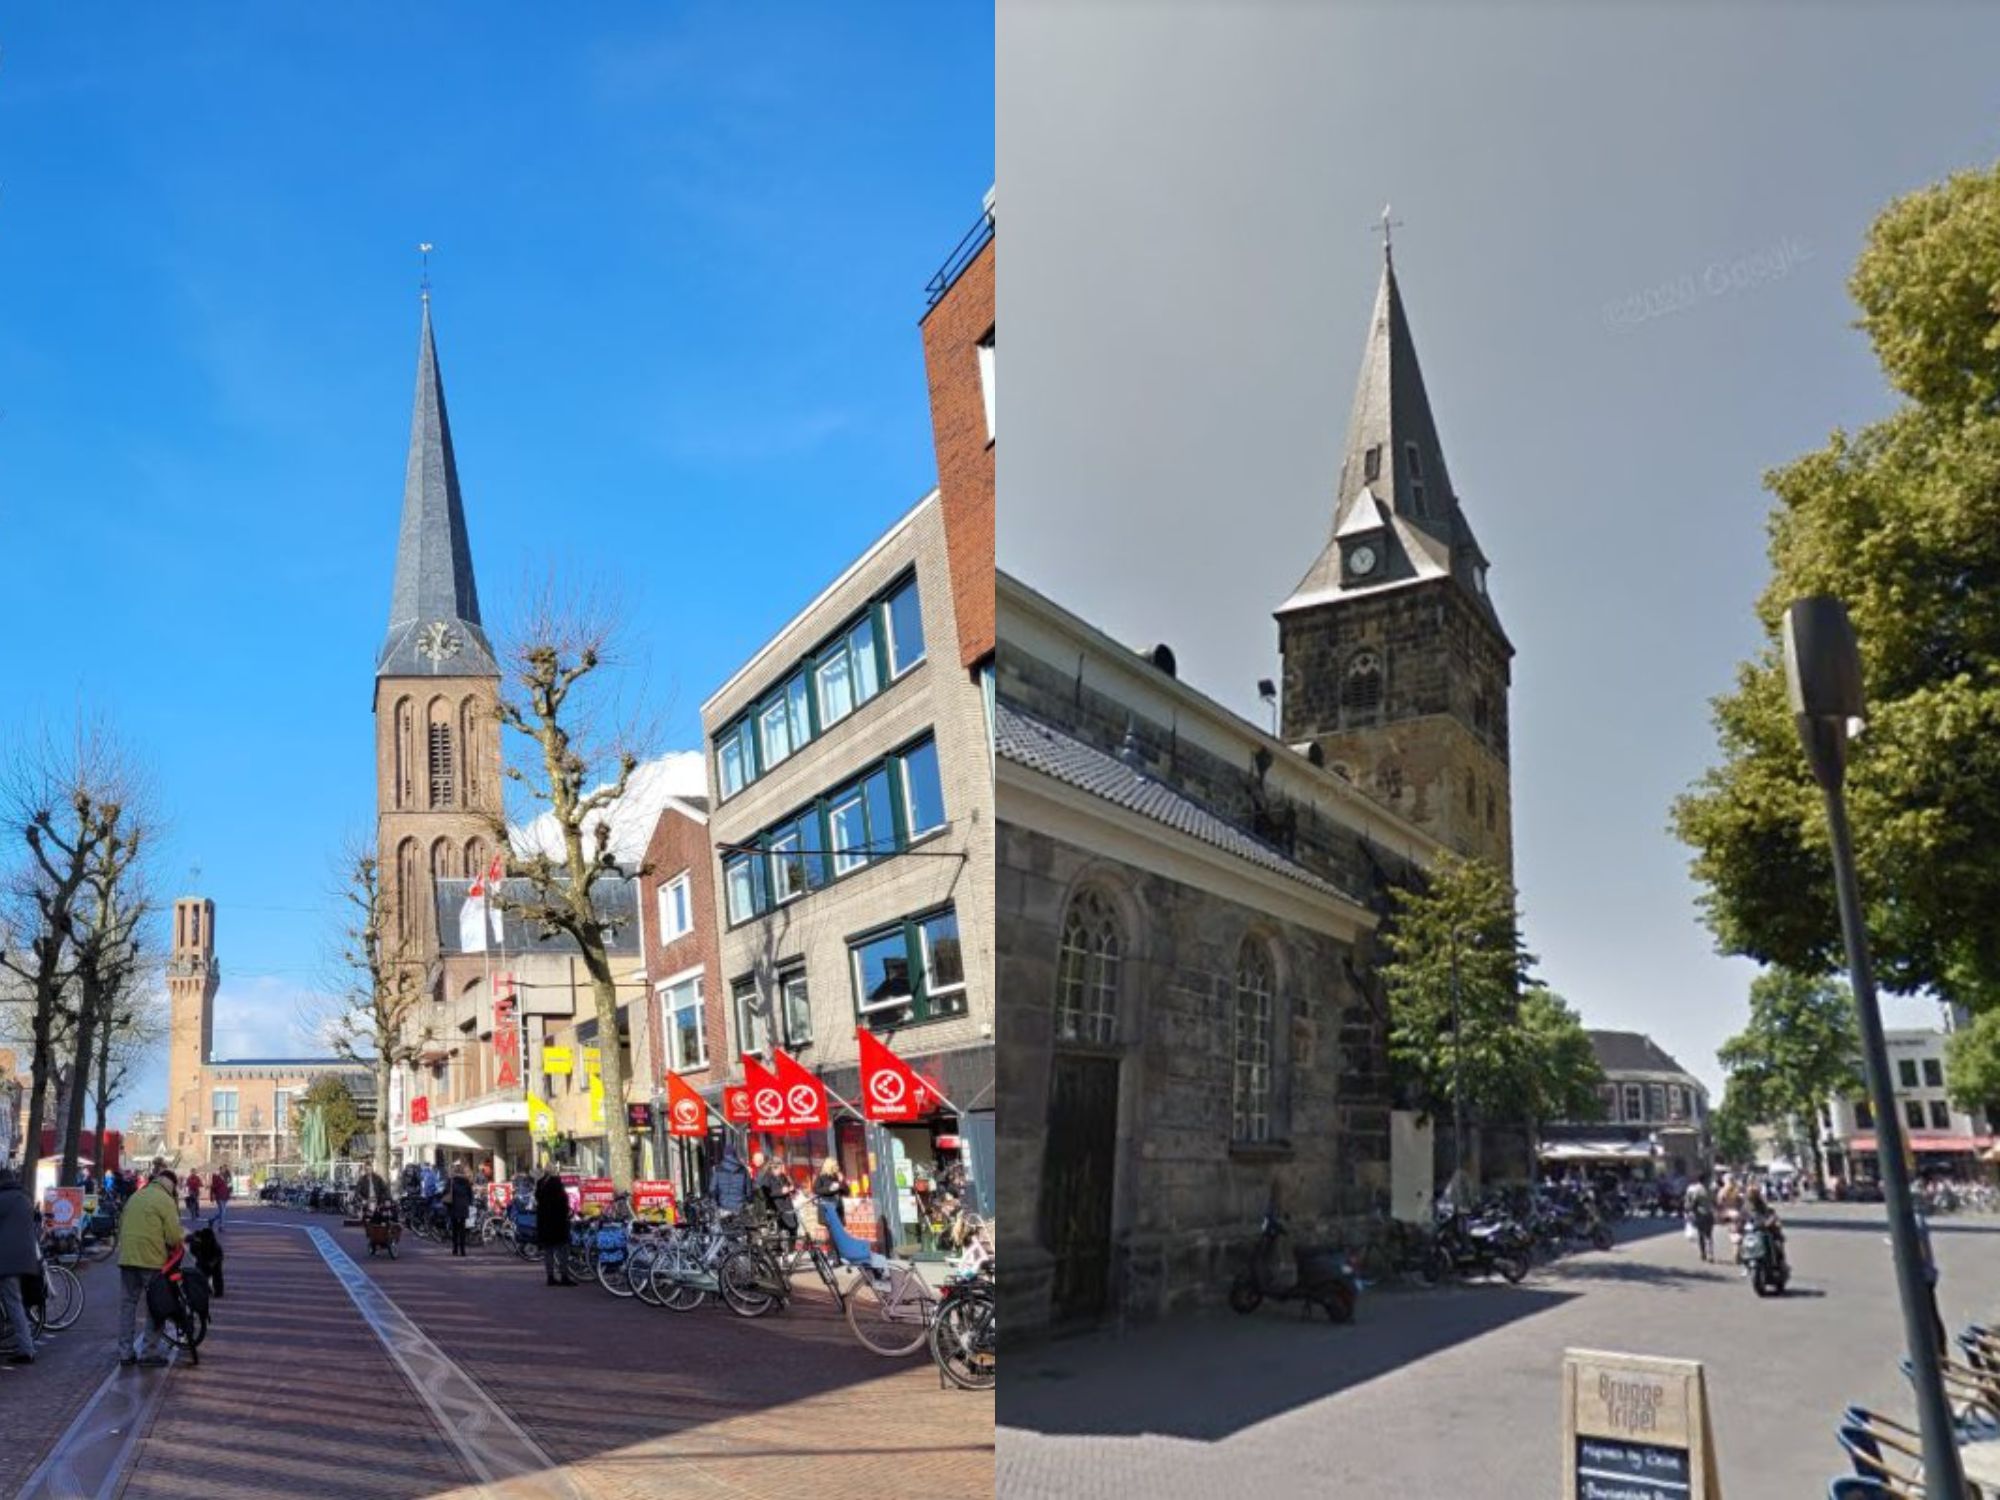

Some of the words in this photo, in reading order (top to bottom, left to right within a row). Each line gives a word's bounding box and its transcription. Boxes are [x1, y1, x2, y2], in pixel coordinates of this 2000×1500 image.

[493, 971, 517, 1087] HEMA
[1600, 1372, 1664, 1408] Brugge
[1608, 1402, 1657, 1435] Tripel
